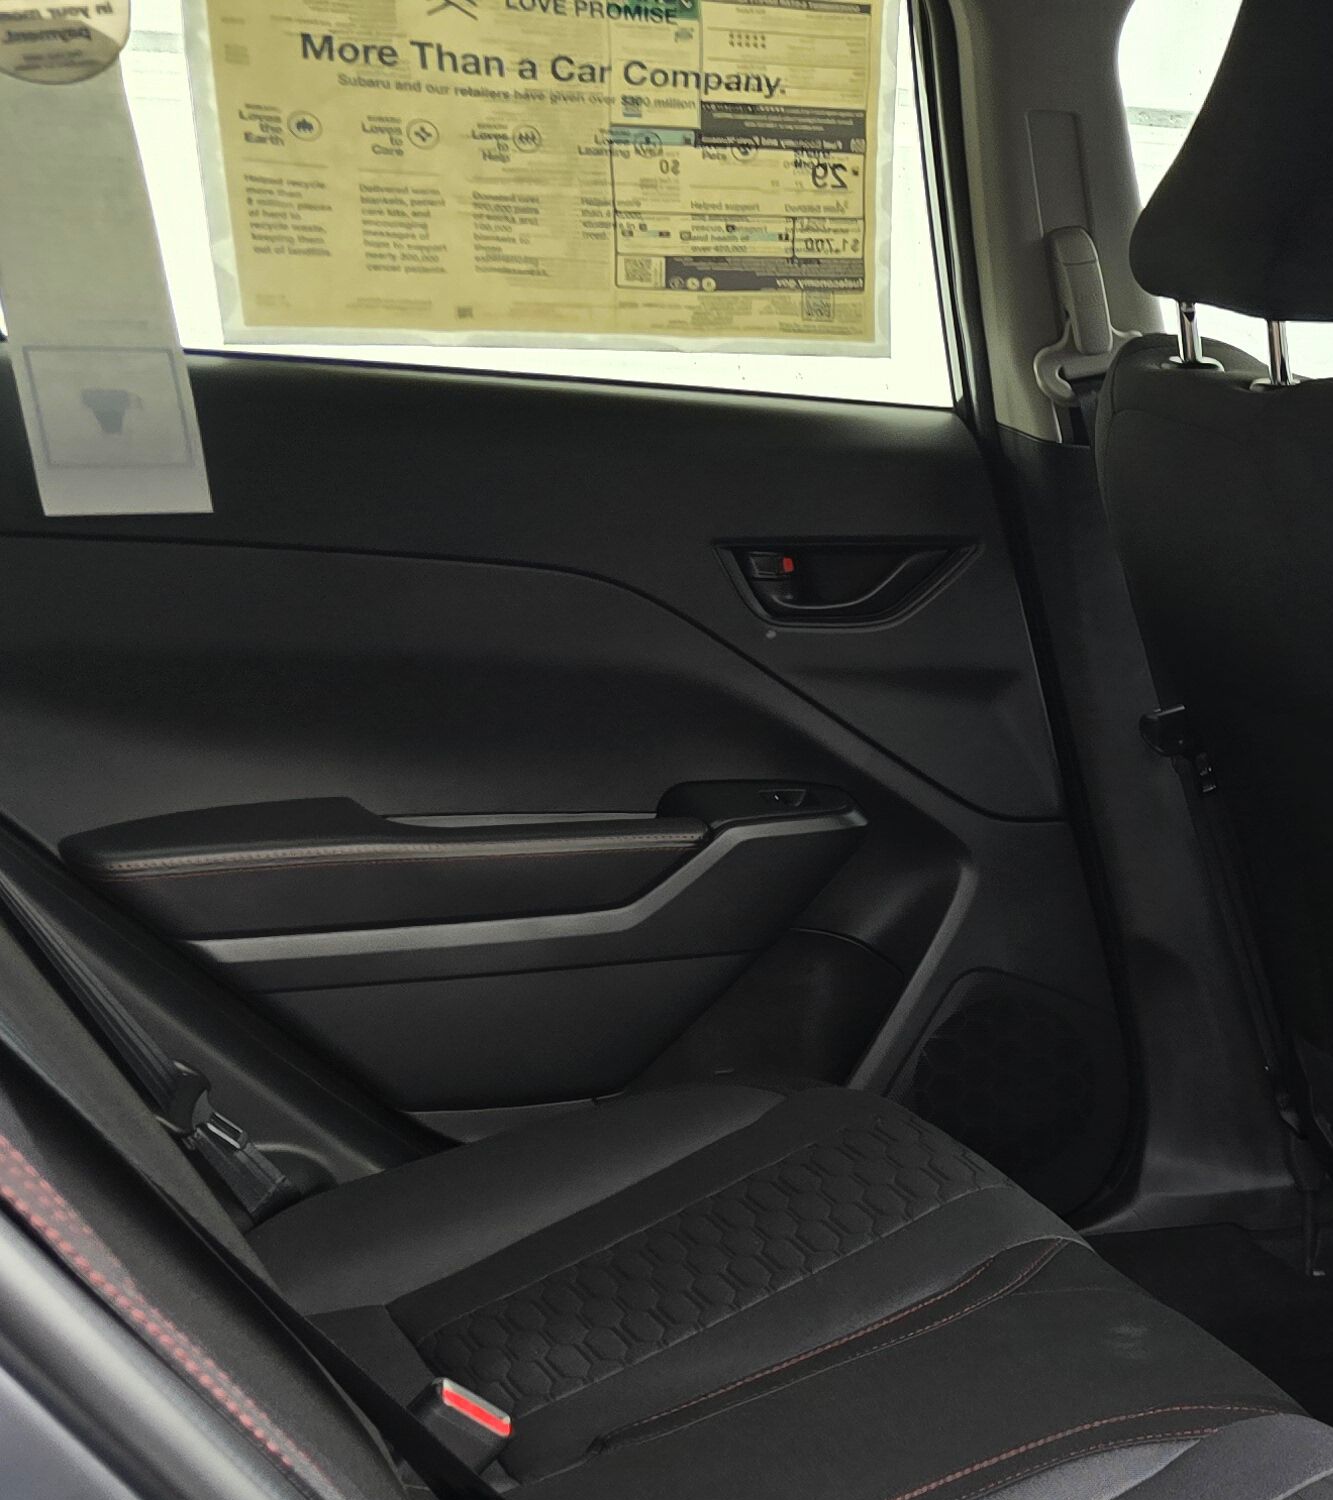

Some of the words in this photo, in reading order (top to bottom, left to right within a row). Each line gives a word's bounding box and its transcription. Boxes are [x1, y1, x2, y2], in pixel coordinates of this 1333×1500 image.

[505, 0, 568, 17] LOVE
[575, 0, 679, 25] PROMISE
[301, 32, 398, 67] More
[409, 40, 506, 78] Than
[517, 58, 538, 81] a
[550, 54, 612, 84] Car
[623, 58, 787, 99] Company.
[337, 73, 391, 91] Subaru
[395, 80, 421, 93] and
[426, 83, 450, 94] our
[454, 85, 510, 101] retailers
[514, 87, 545, 102] have
